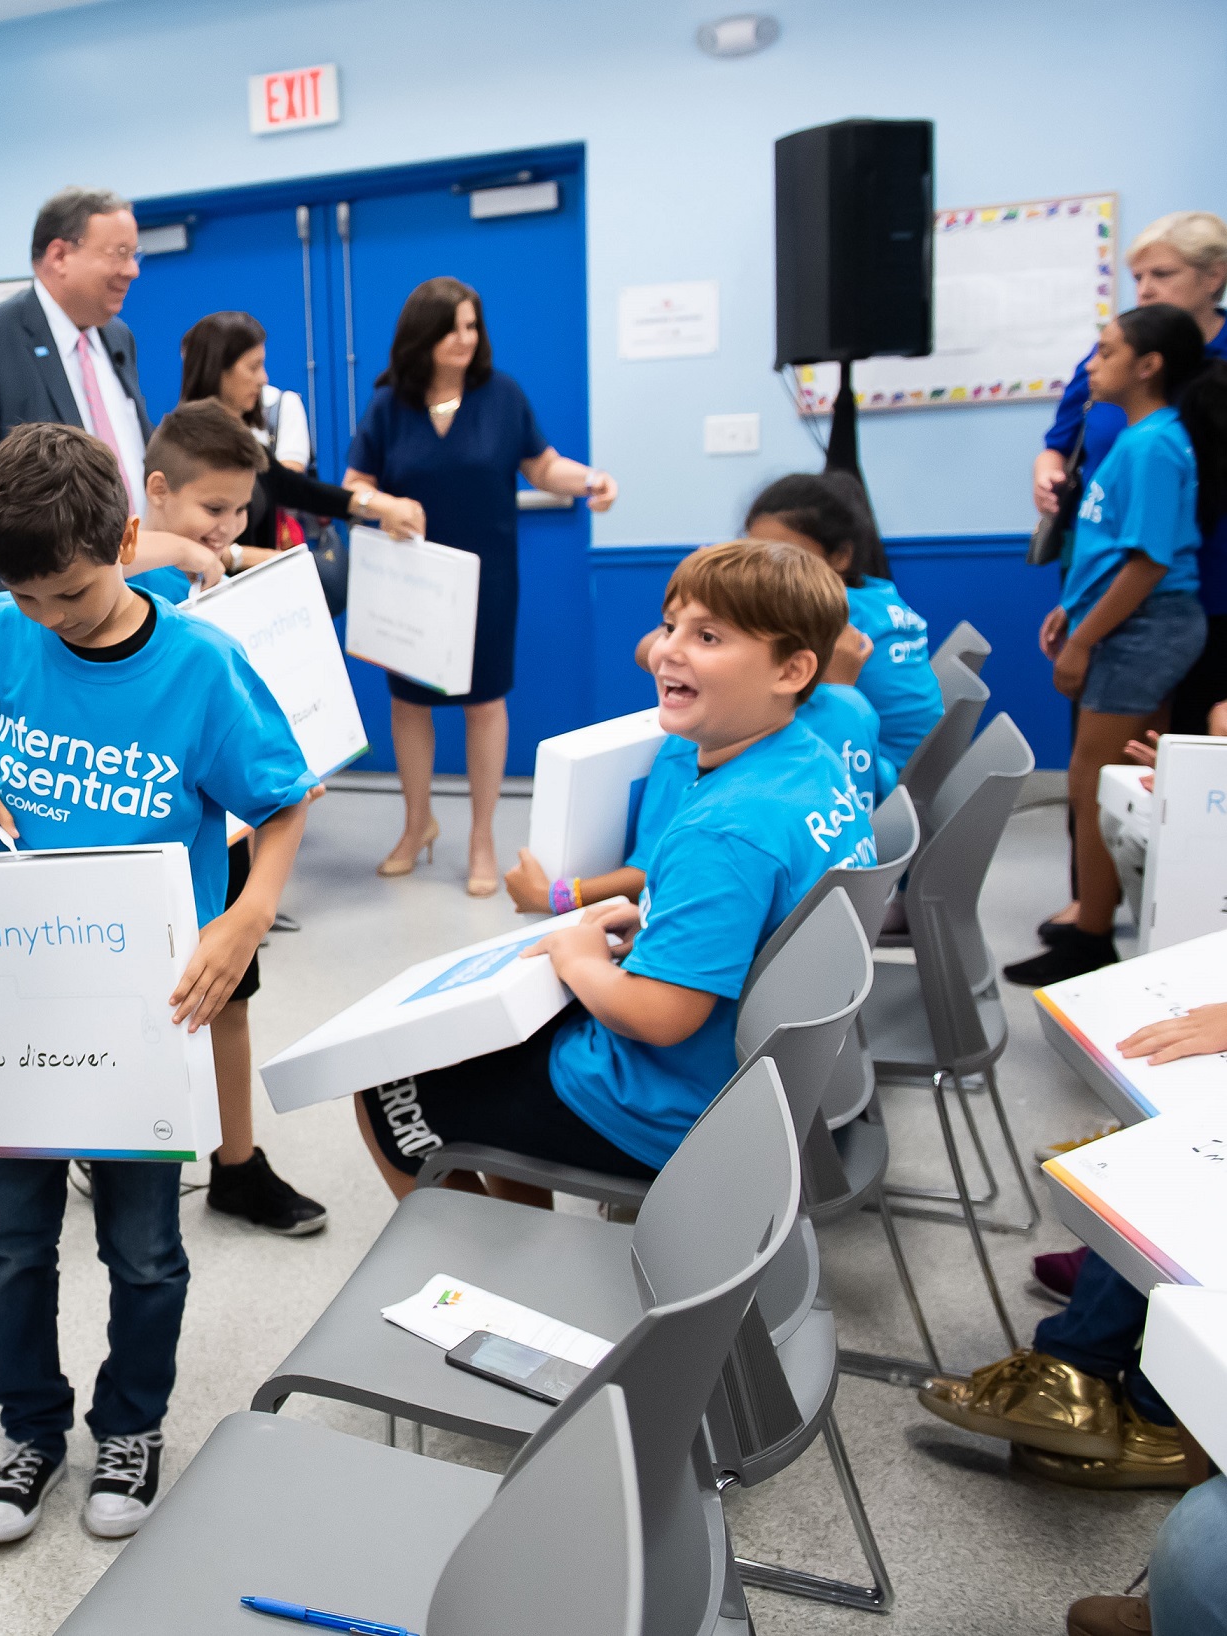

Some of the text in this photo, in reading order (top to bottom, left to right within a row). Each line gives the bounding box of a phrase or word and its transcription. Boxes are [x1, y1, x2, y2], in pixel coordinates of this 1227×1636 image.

[266, 71, 322, 123] EXIT
[0, 755, 173, 819] ssentials
[6, 793, 71, 823] COMCAST
[19, 1044, 117, 1067] discover.
